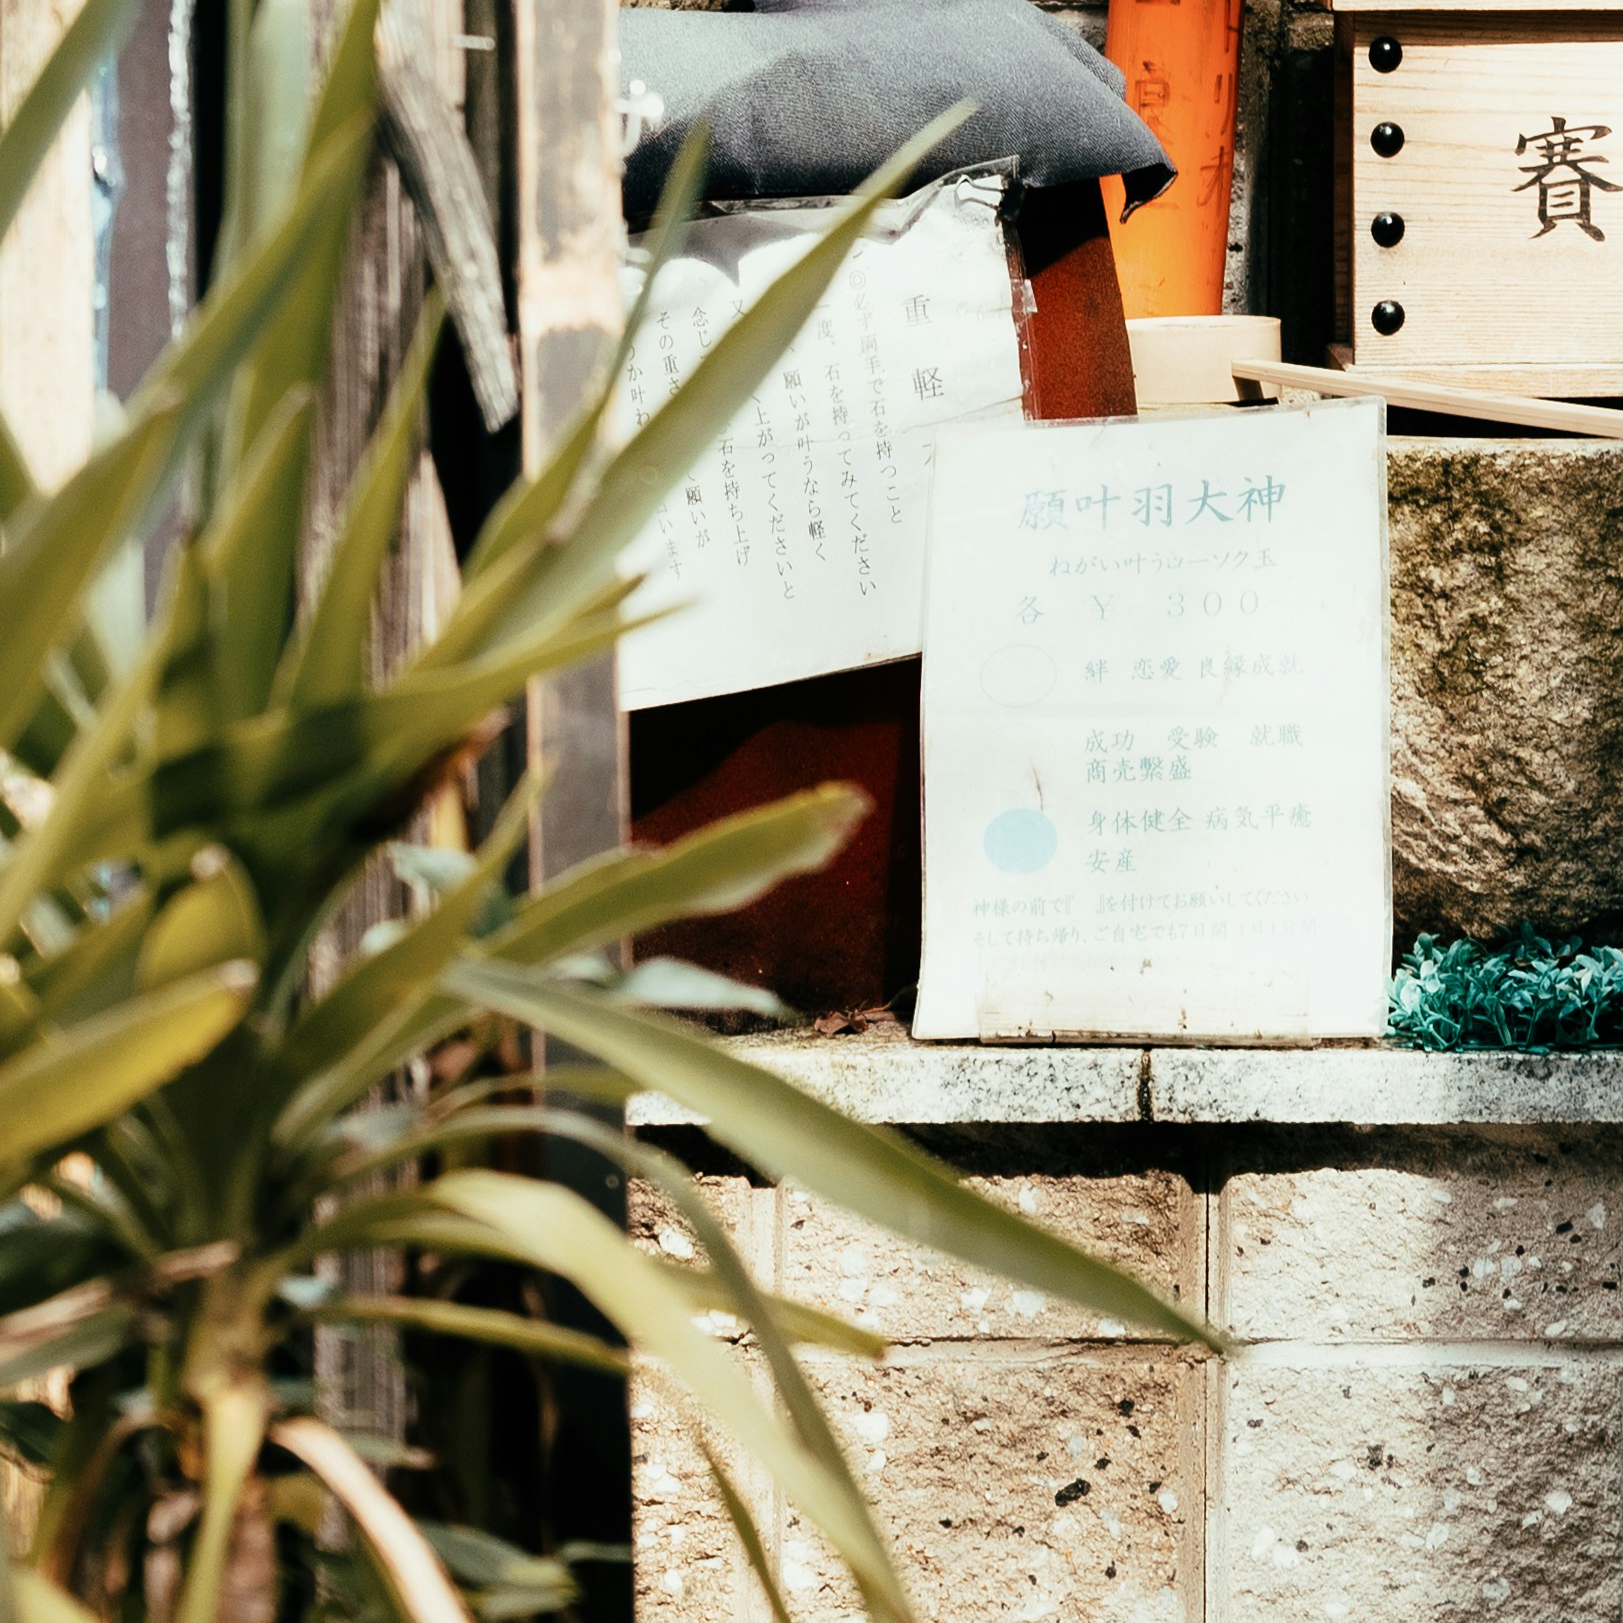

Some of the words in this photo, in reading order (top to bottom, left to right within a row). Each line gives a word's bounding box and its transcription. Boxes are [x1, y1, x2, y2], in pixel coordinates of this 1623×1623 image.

[1018, 474, 1287, 531] 願叶羽大神
[1014, 594, 1047, 626] 各
[1084, 658, 1109, 684] 絆
[1131, 655, 1183, 681] 恋愛
[1084, 727, 1135, 754] 成功
[1167, 724, 1221, 751] 受験
[1250, 722, 1304, 747] 就職
[1087, 806, 1194, 837] 身体健全
[1205, 802, 1313, 832] 病気平癒
[1085, 846, 1138, 875] 安産
